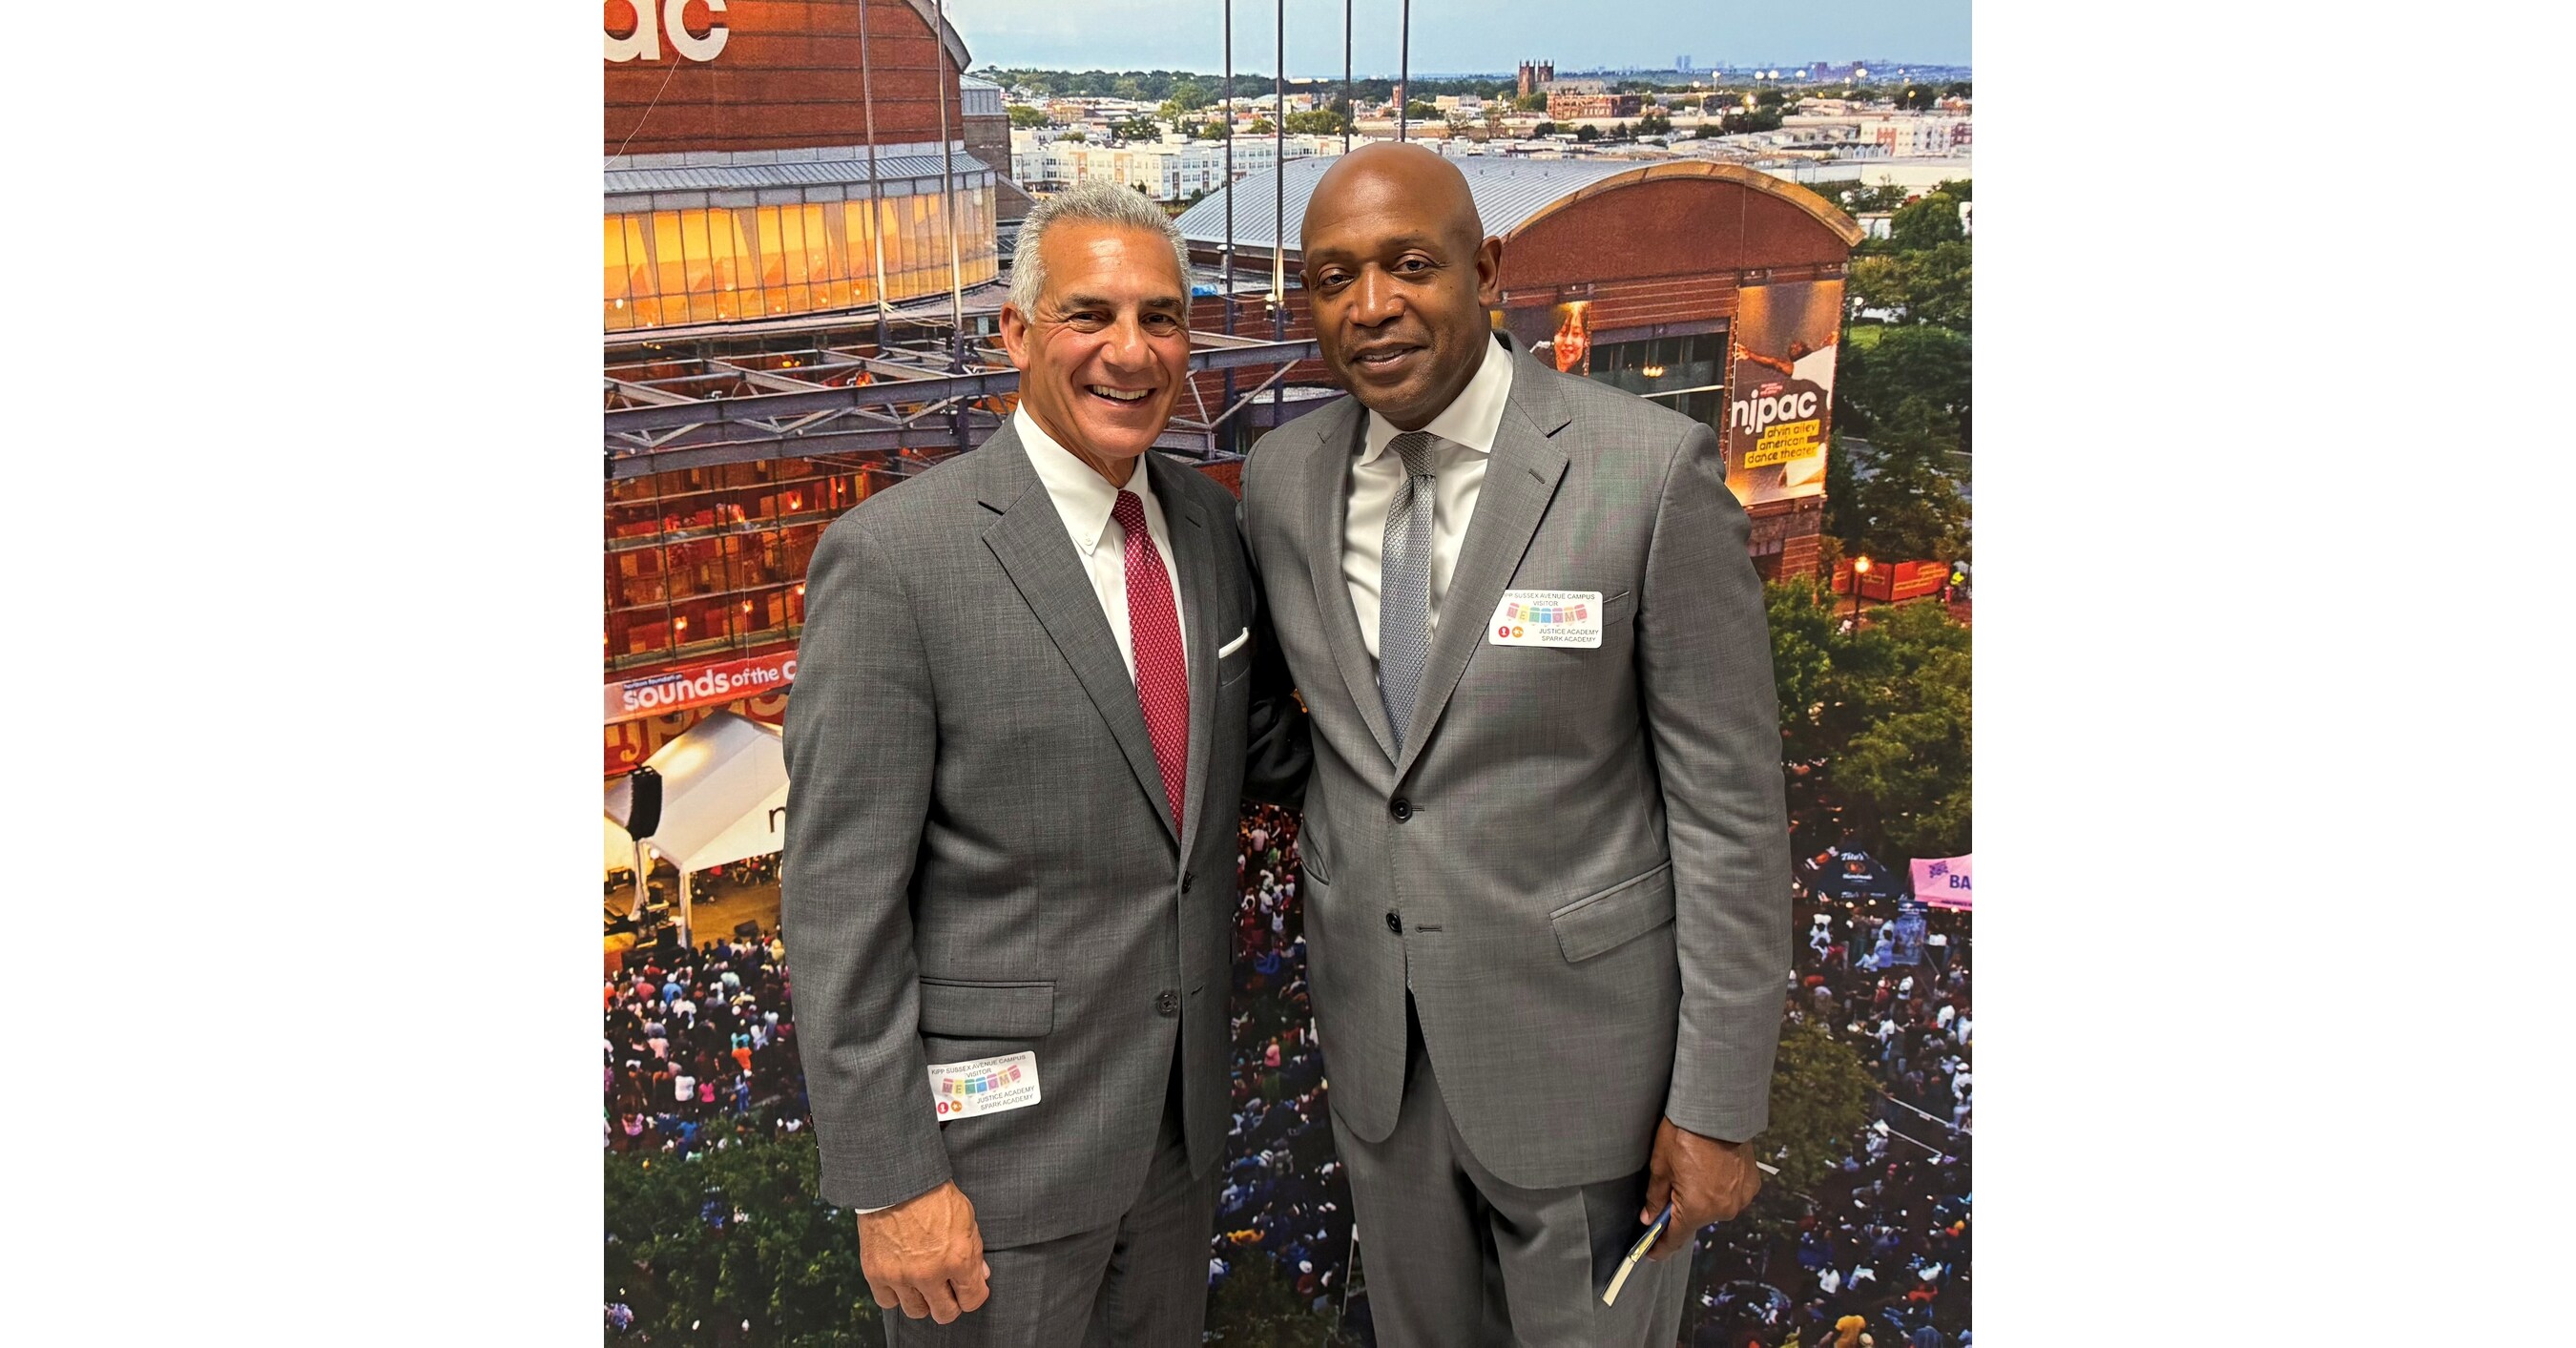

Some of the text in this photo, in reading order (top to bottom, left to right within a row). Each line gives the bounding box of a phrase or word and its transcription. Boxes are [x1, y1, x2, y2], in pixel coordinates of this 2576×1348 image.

[1732, 389, 1817, 435] njpac
[1767, 423, 1817, 438] alvin ailey
[1759, 436, 1805, 451] american
[1747, 446, 1817, 464] dance theater
[623, 669, 730, 711] sounds
[731, 668, 750, 687] of
[750, 667, 779, 685] the
[945, 1065, 971, 1074] SUSSEX
[972, 1060, 998, 1069] AVENUE
[998, 1054, 1027, 1064] CAMPUS
[966, 1068, 992, 1078] VISITOR
[977, 1085, 1035, 1105] JUSTICE ACADEMY
[980, 1093, 1033, 1110] SPARK ACADEMY
